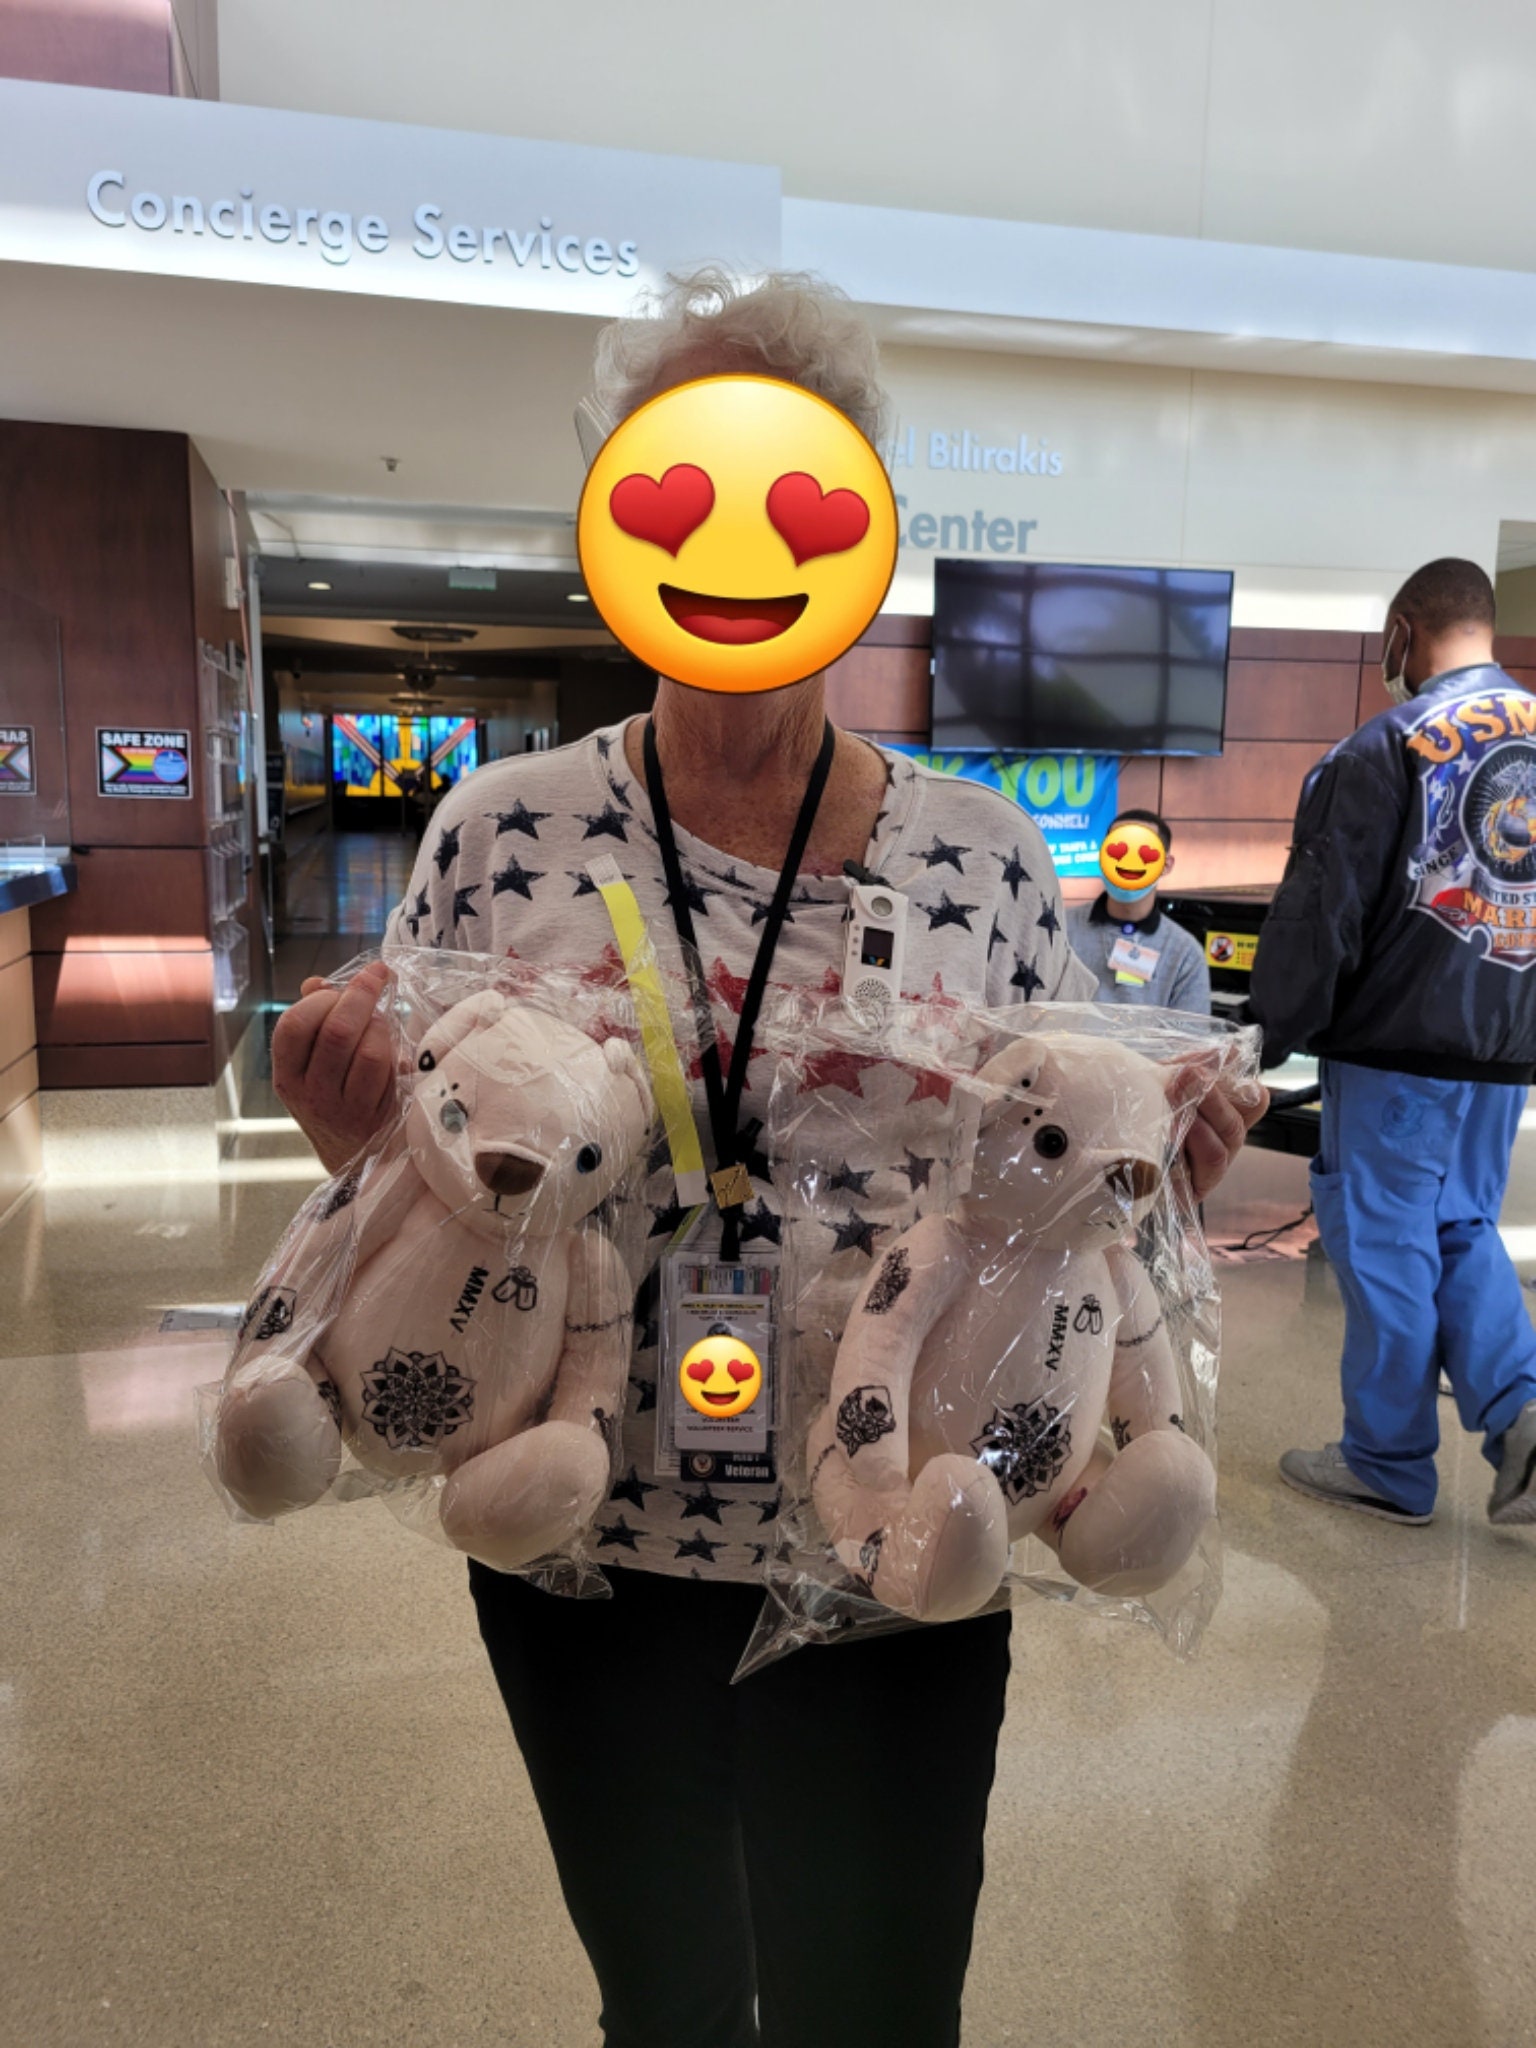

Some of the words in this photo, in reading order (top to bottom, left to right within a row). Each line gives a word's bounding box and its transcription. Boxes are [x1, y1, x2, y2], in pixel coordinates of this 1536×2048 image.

[87, 169, 389, 265] Concierge
[412, 203, 640, 277] Services
[929, 429, 1063, 476] Bilirakis
[102, 733, 140, 746] SAFE
[144, 735, 185, 748] ZONE
[989, 754, 1096, 807] YOU
[1413, 846, 1456, 879] SINCE
[449, 1266, 489, 1334] MMXV
[1044, 1304, 1069, 1371] MMXV
[725, 1464, 769, 1479] Veteran
